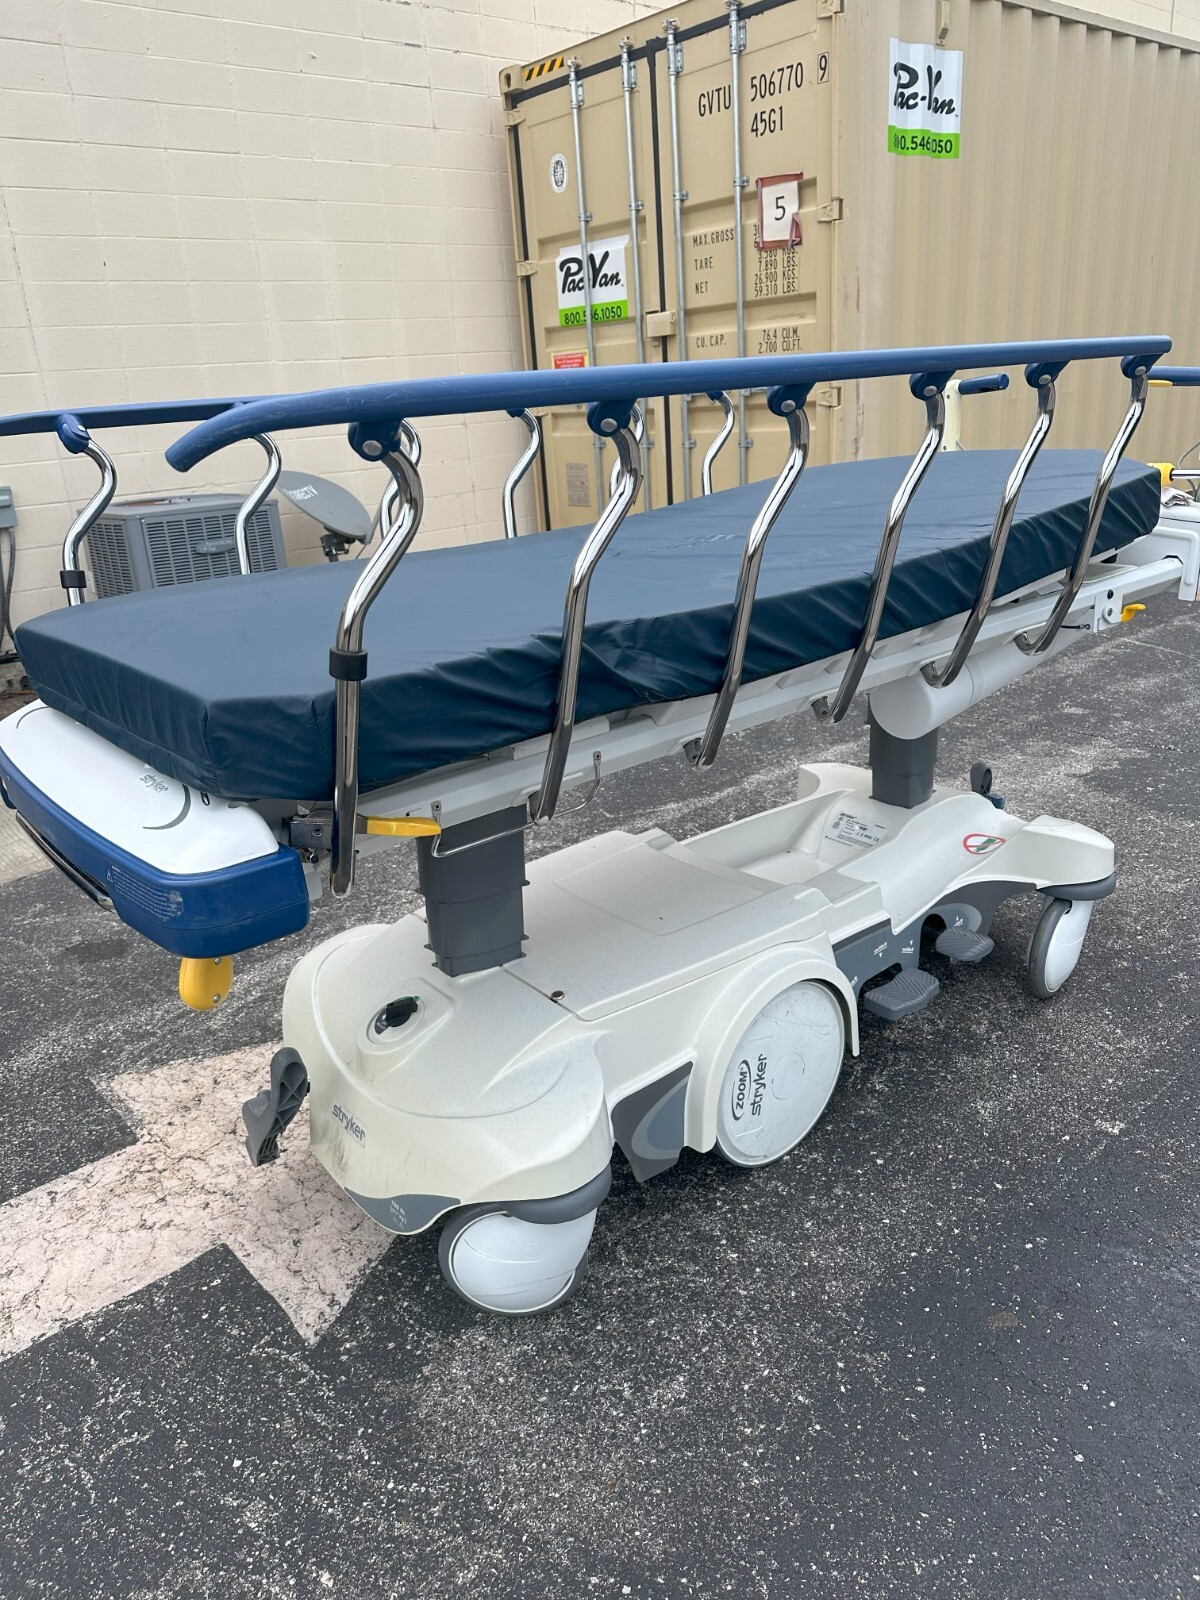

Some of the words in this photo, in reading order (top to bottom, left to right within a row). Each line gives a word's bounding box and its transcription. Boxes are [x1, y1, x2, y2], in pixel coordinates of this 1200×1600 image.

[698, 84, 732, 117] GVTU
[750, 62, 804, 102] 506770
[819, 54, 827, 82] 9
[750, 105, 783, 138] 45G1
[774, 195, 786, 221] 5
[692, 228, 735, 248] MAX.GROSS
[559, 250, 622, 294] PacVan
[694, 256, 714, 271] TARE
[758, 259, 777, 273] 7.890
[782, 255, 798, 268] LBS.
[754, 271, 777, 286] 26.900
[782, 268, 798, 281] KGS.
[695, 281, 709, 294] NET
[754, 283, 778, 298] 59.310
[782, 281, 798, 294] LBS.
[564, 305, 622, 325] 800.56.1050
[762, 328, 777, 341] 76.4
[758, 341, 777, 354] 2.700
[735, 1071, 748, 1110] ZOOM
[750, 1053, 767, 1116] stryker
[331, 1104, 366, 1141] stryker
